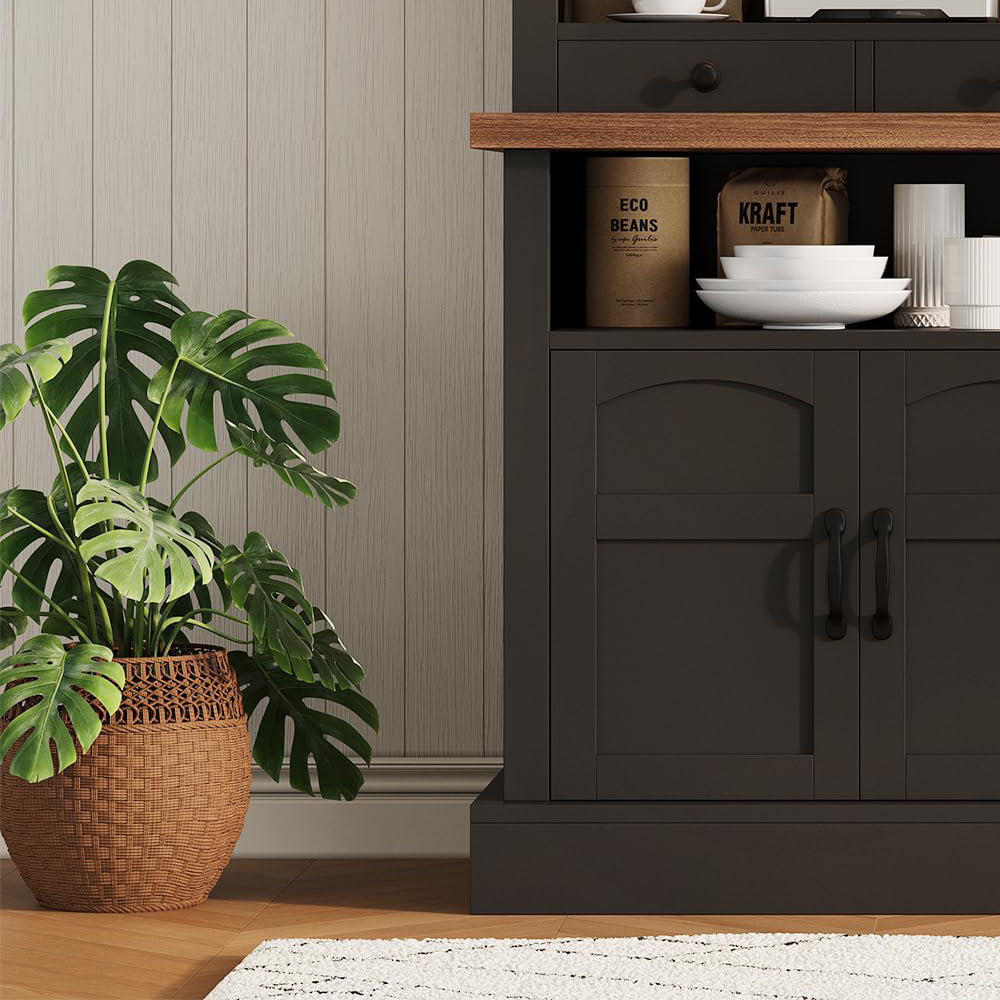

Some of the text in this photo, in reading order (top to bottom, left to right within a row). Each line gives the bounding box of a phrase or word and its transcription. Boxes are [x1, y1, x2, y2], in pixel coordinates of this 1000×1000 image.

[620, 198, 648, 212] ECO
[738, 202, 798, 225] KRAFT
[610, 218, 658, 232] BEANS
